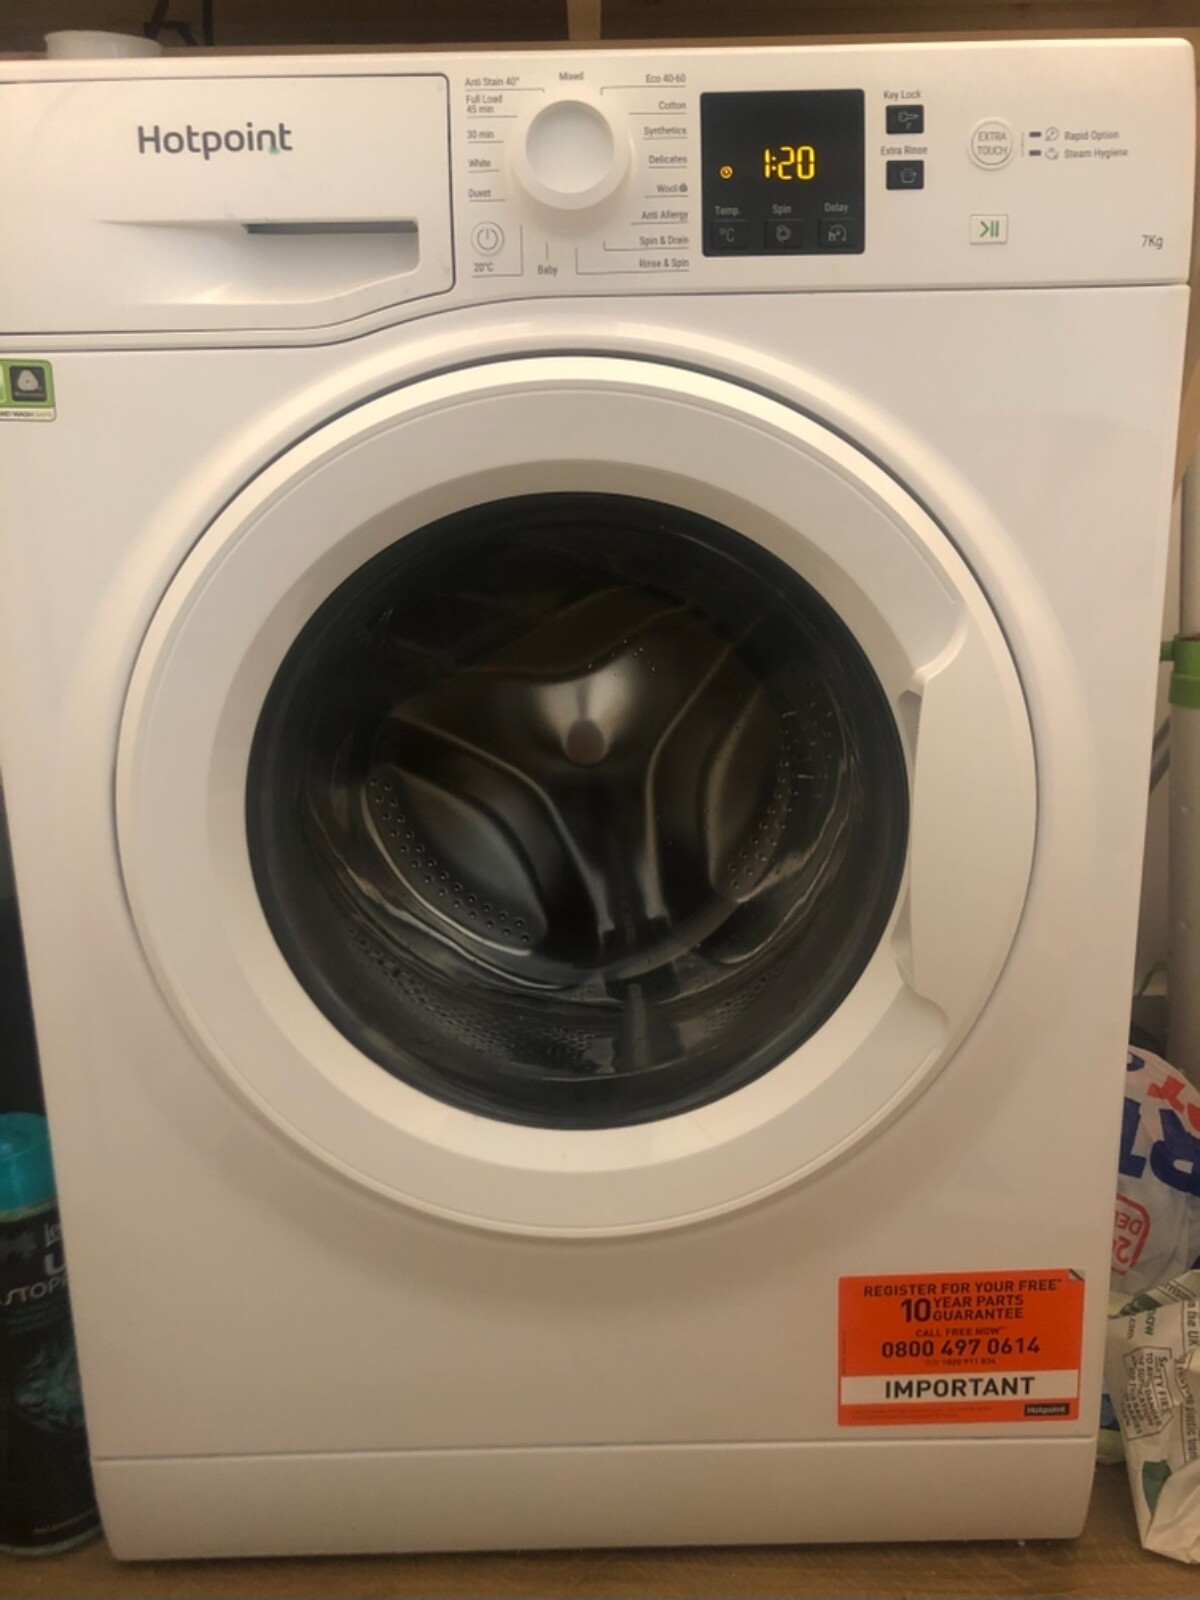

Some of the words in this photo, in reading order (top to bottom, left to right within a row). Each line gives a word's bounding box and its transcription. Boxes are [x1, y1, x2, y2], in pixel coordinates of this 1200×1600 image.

[558, 71, 584, 81] Mixed
[645, 74, 661, 84] Eco
[663, 73, 687, 83] 40-60
[464, 77, 481, 87] Anti
[483, 77, 504, 86] Stain
[466, 95, 480, 104] Full
[482, 94, 503, 104] Load
[883, 90, 899, 100] Key
[901, 90, 921, 100] Lock
[466, 105, 477, 114] 45
[479, 105, 494, 114] min
[658, 101, 687, 111] Cotton
[466, 130, 477, 139] 30
[479, 130, 494, 139] min
[643, 126, 688, 137] Synthetics
[978, 131, 1007, 142] EXTRA
[1064, 130, 1089, 142] Rapid
[1091, 129, 1120, 141] Option
[137, 121, 293, 161] Hotpoint
[881, 145, 904, 156] Extra
[905, 145, 928, 155] Rinse
[977, 146, 1008, 156] TOUCH
[1064, 148, 1092, 158] Steam
[1094, 147, 1129, 160] Hygiene
[468, 159, 491, 168] White
[648, 155, 688, 165] Delicates
[763, 145, 816, 180] 1:20
[468, 189, 492, 198] Duvet
[656, 184, 678, 193] Wool
[715, 206, 741, 216] Temp.
[772, 204, 792, 215] Spin
[824, 203, 849, 214] Delay
[641, 211, 658, 220] Anti
[660, 210, 689, 223] Allergy
[639, 236, 658, 247] Spin
[660, 236, 666, 245] &
[667, 235, 689, 245] Drain
[1141, 234, 1164, 250] 7Kg
[639, 259, 662, 269] Rinse
[664, 258, 670, 268] &
[671, 257, 690, 269] Spin
[537, 265, 558, 277] Baby
[864, 1283, 937, 1297] REGISTER
[941, 1281, 970, 1294] FOR
[975, 1278, 1015, 1293] YOUR
[934, 1296, 973, 1308] YEAR
[977, 1294, 1024, 1306] PARTS
[901, 1297, 931, 1323] 10
[933, 1308, 1023, 1321] GUARANTEE
[916, 1328, 942, 1338] CALL
[945, 1327, 972, 1337] FREE
[881, 1340, 934, 1358] 0800
[941, 1339, 980, 1356] 497
[987, 1337, 1040, 1354] 0614
[885, 1376, 1035, 1399] IMPORTANT
[1026, 1403, 1066, 1415] Hotpoint
